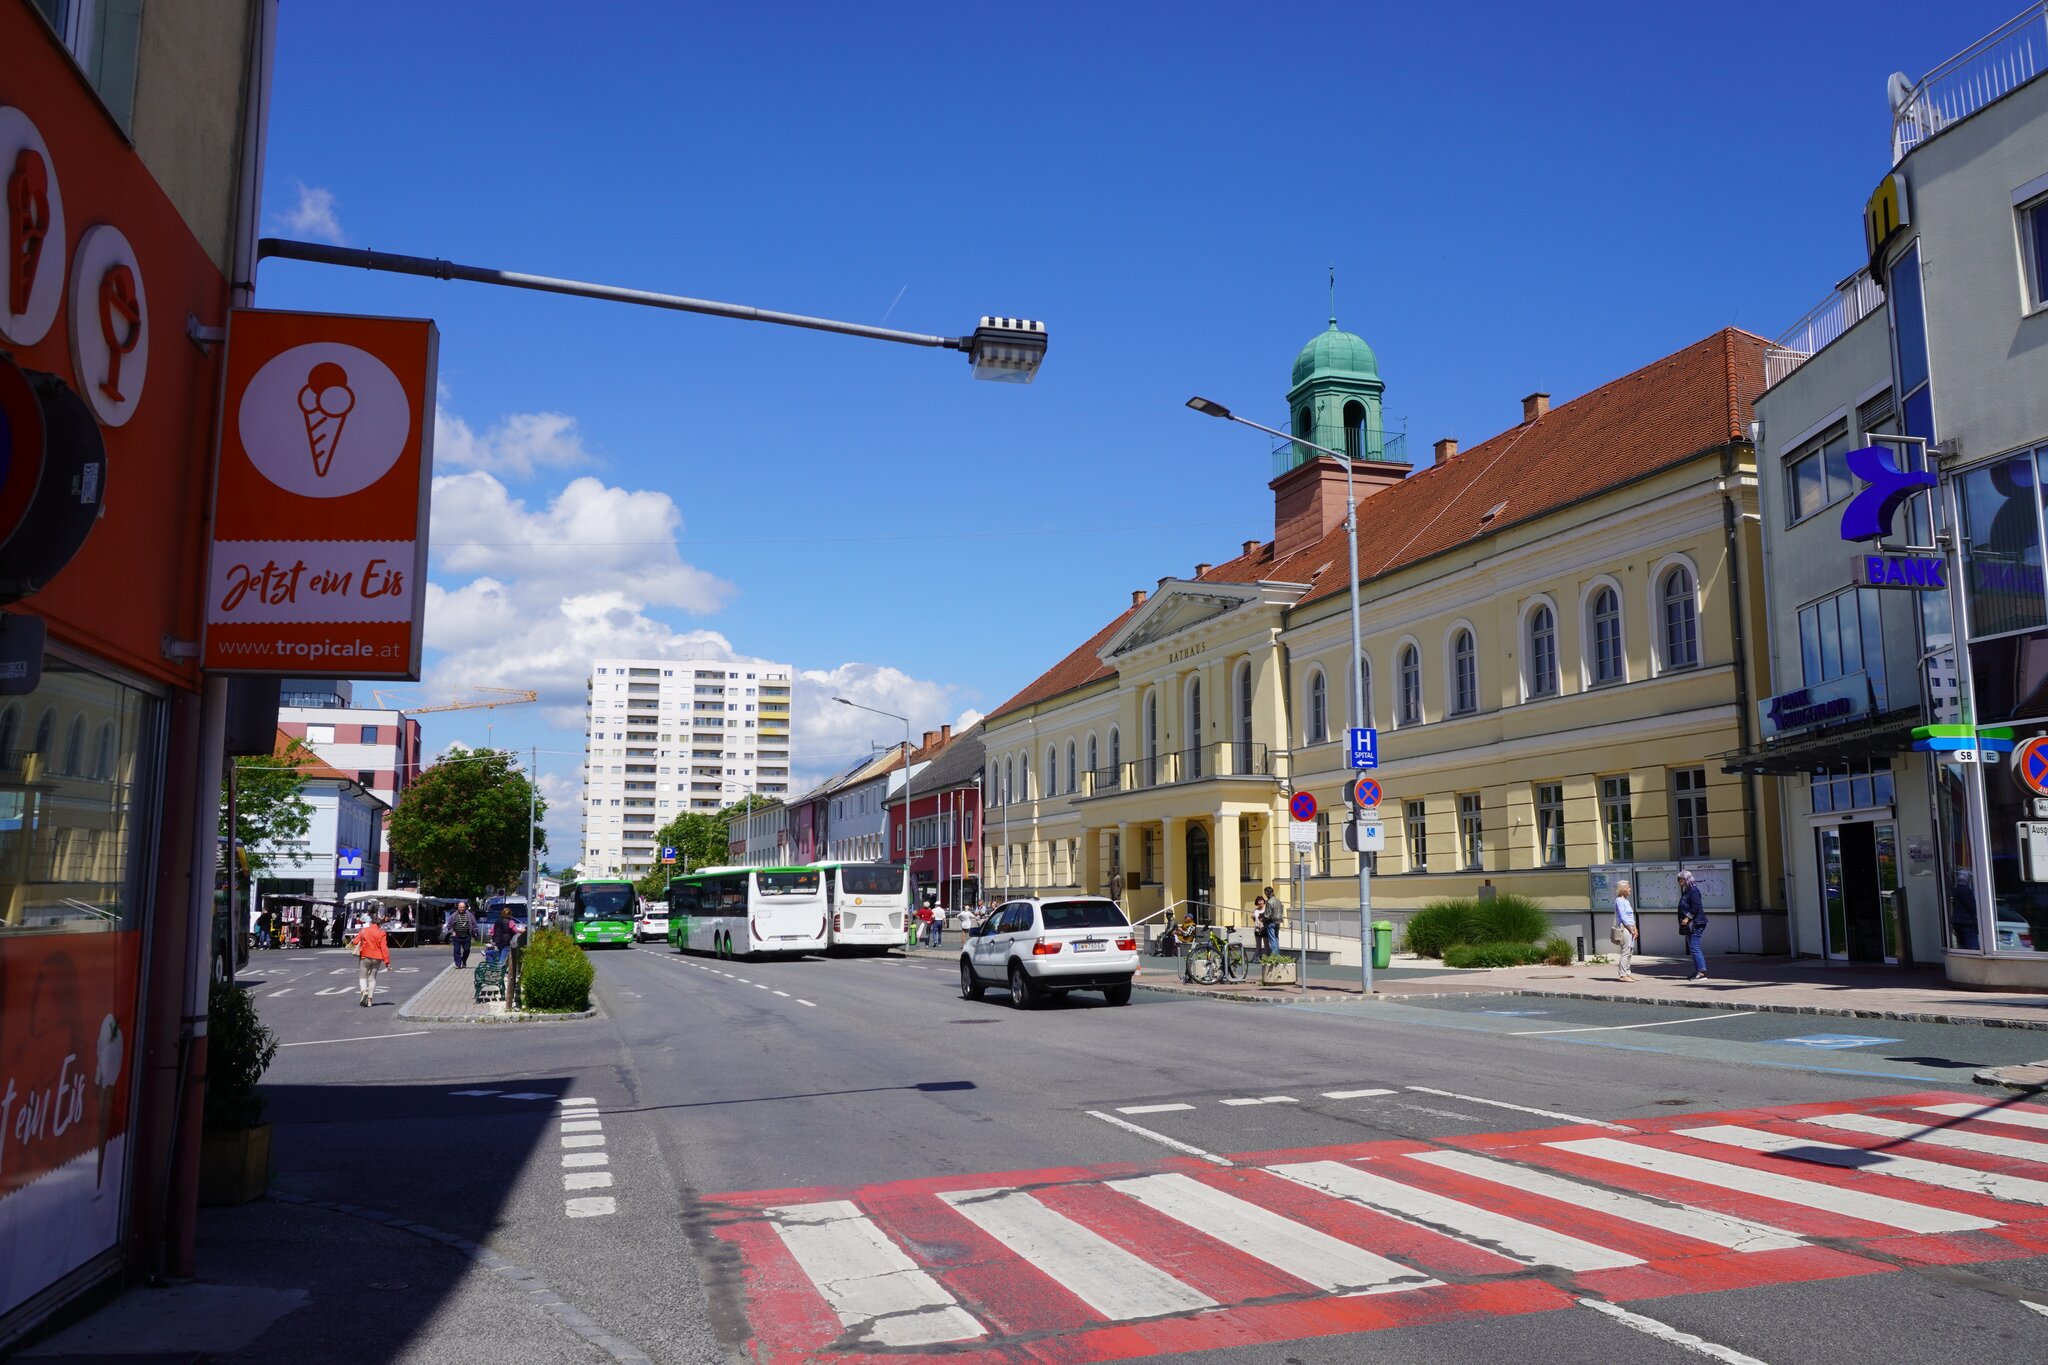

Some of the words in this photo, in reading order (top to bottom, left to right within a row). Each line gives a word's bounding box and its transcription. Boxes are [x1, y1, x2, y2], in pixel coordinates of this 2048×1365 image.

[1867, 557, 1945, 587] BANK
[221, 560, 308, 612] Jetzt
[309, 569, 353, 597] ein
[360, 559, 404, 599] Eis
[218, 638, 401, 661] www.tropicale.at
[1169, 641, 1206, 664] RATHAUS
[1782, 689, 1810, 711] BANK
[1782, 698, 1850, 730] BURGENLAND
[1357, 730, 1371, 751] H
[1354, 751, 1375, 759] SPITAL
[1960, 751, 1973, 760] SB
[665, 848, 673, 858] P
[15, 1090, 51, 1146] ein
[53, 1053, 86, 1138] Eis
